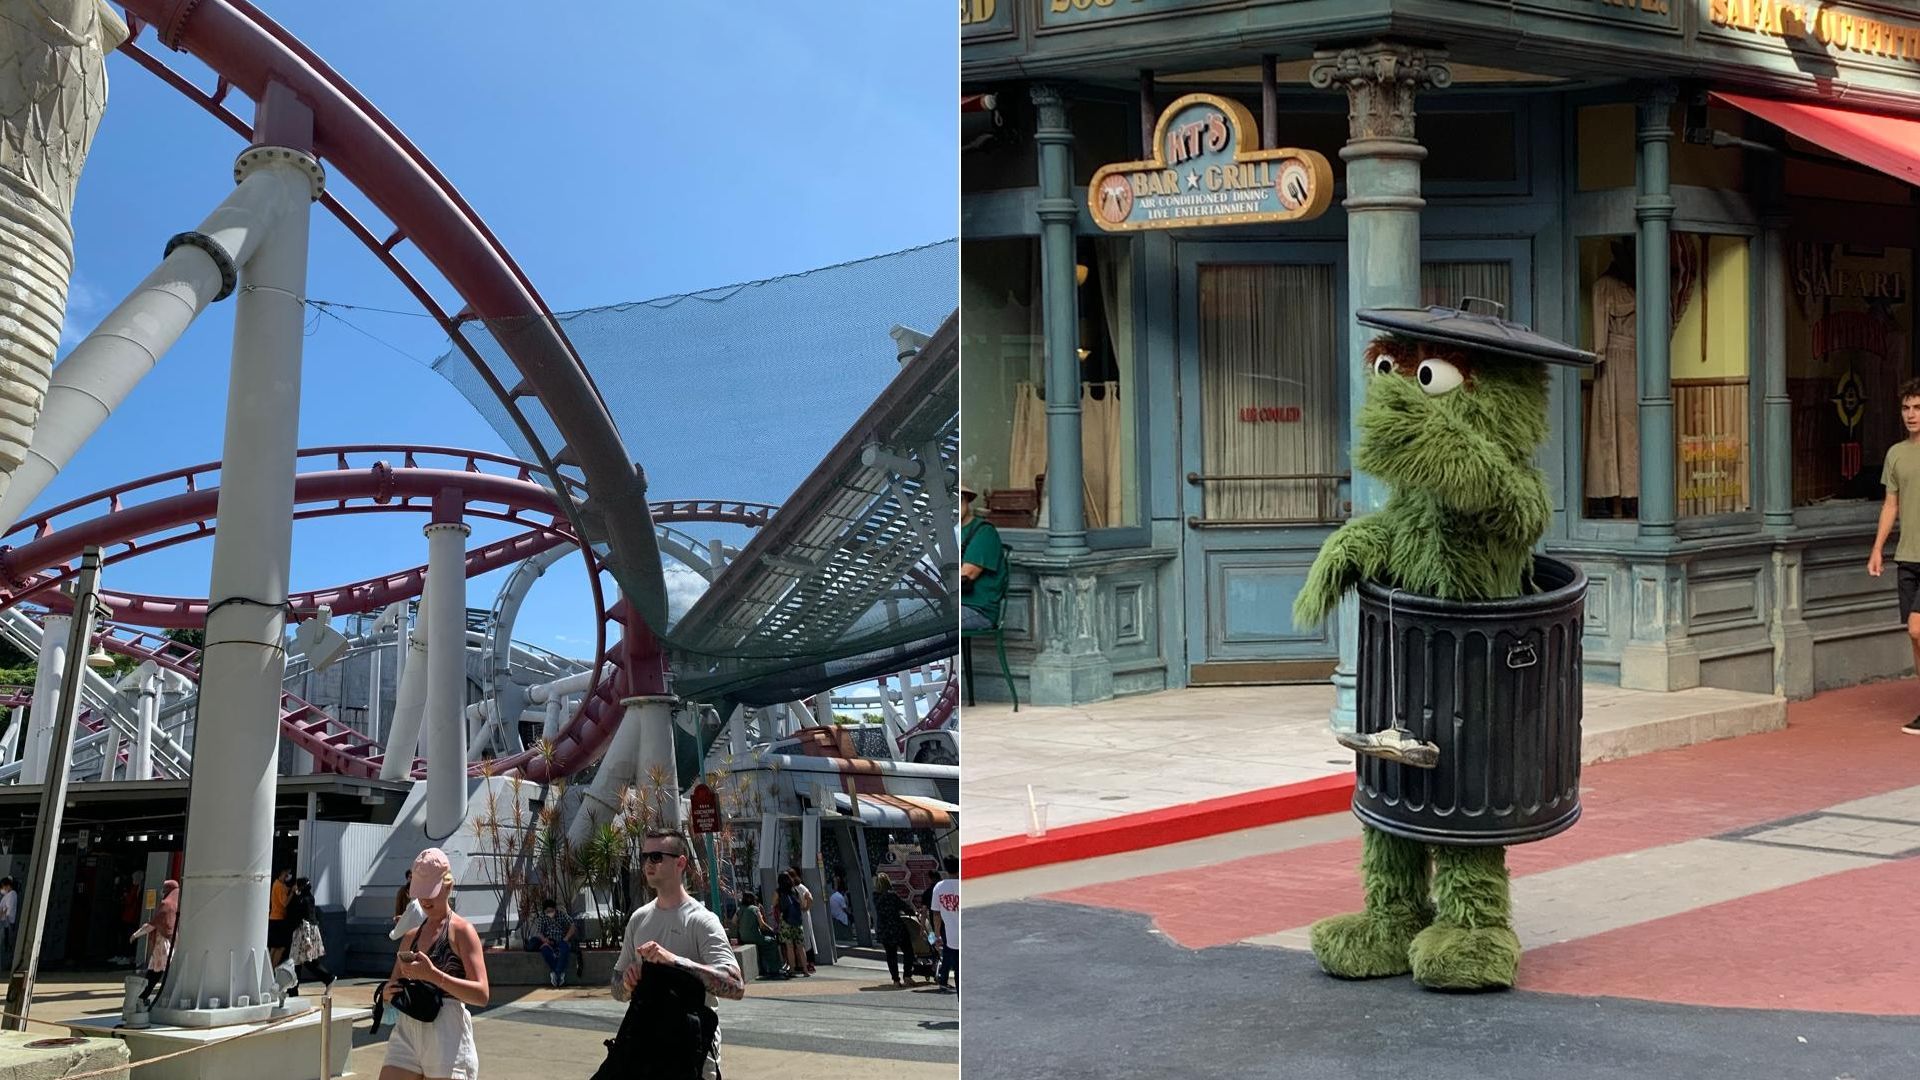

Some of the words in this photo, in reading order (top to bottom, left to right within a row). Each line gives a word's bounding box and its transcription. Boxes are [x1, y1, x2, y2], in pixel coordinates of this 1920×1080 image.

[1167, 112, 1229, 163] KT'S
[1132, 169, 1180, 197] BAR
[1206, 161, 1275, 192] GRILL
[1139, 198, 1156, 209] AIR
[1158, 192, 1228, 208] CONDITIONED
[1232, 189, 1269, 203] DINING
[1148, 208, 1170, 220] LIVE
[1174, 201, 1260, 218] ENTERTAINMENT
[1796, 268, 1903, 298] SAFARI
